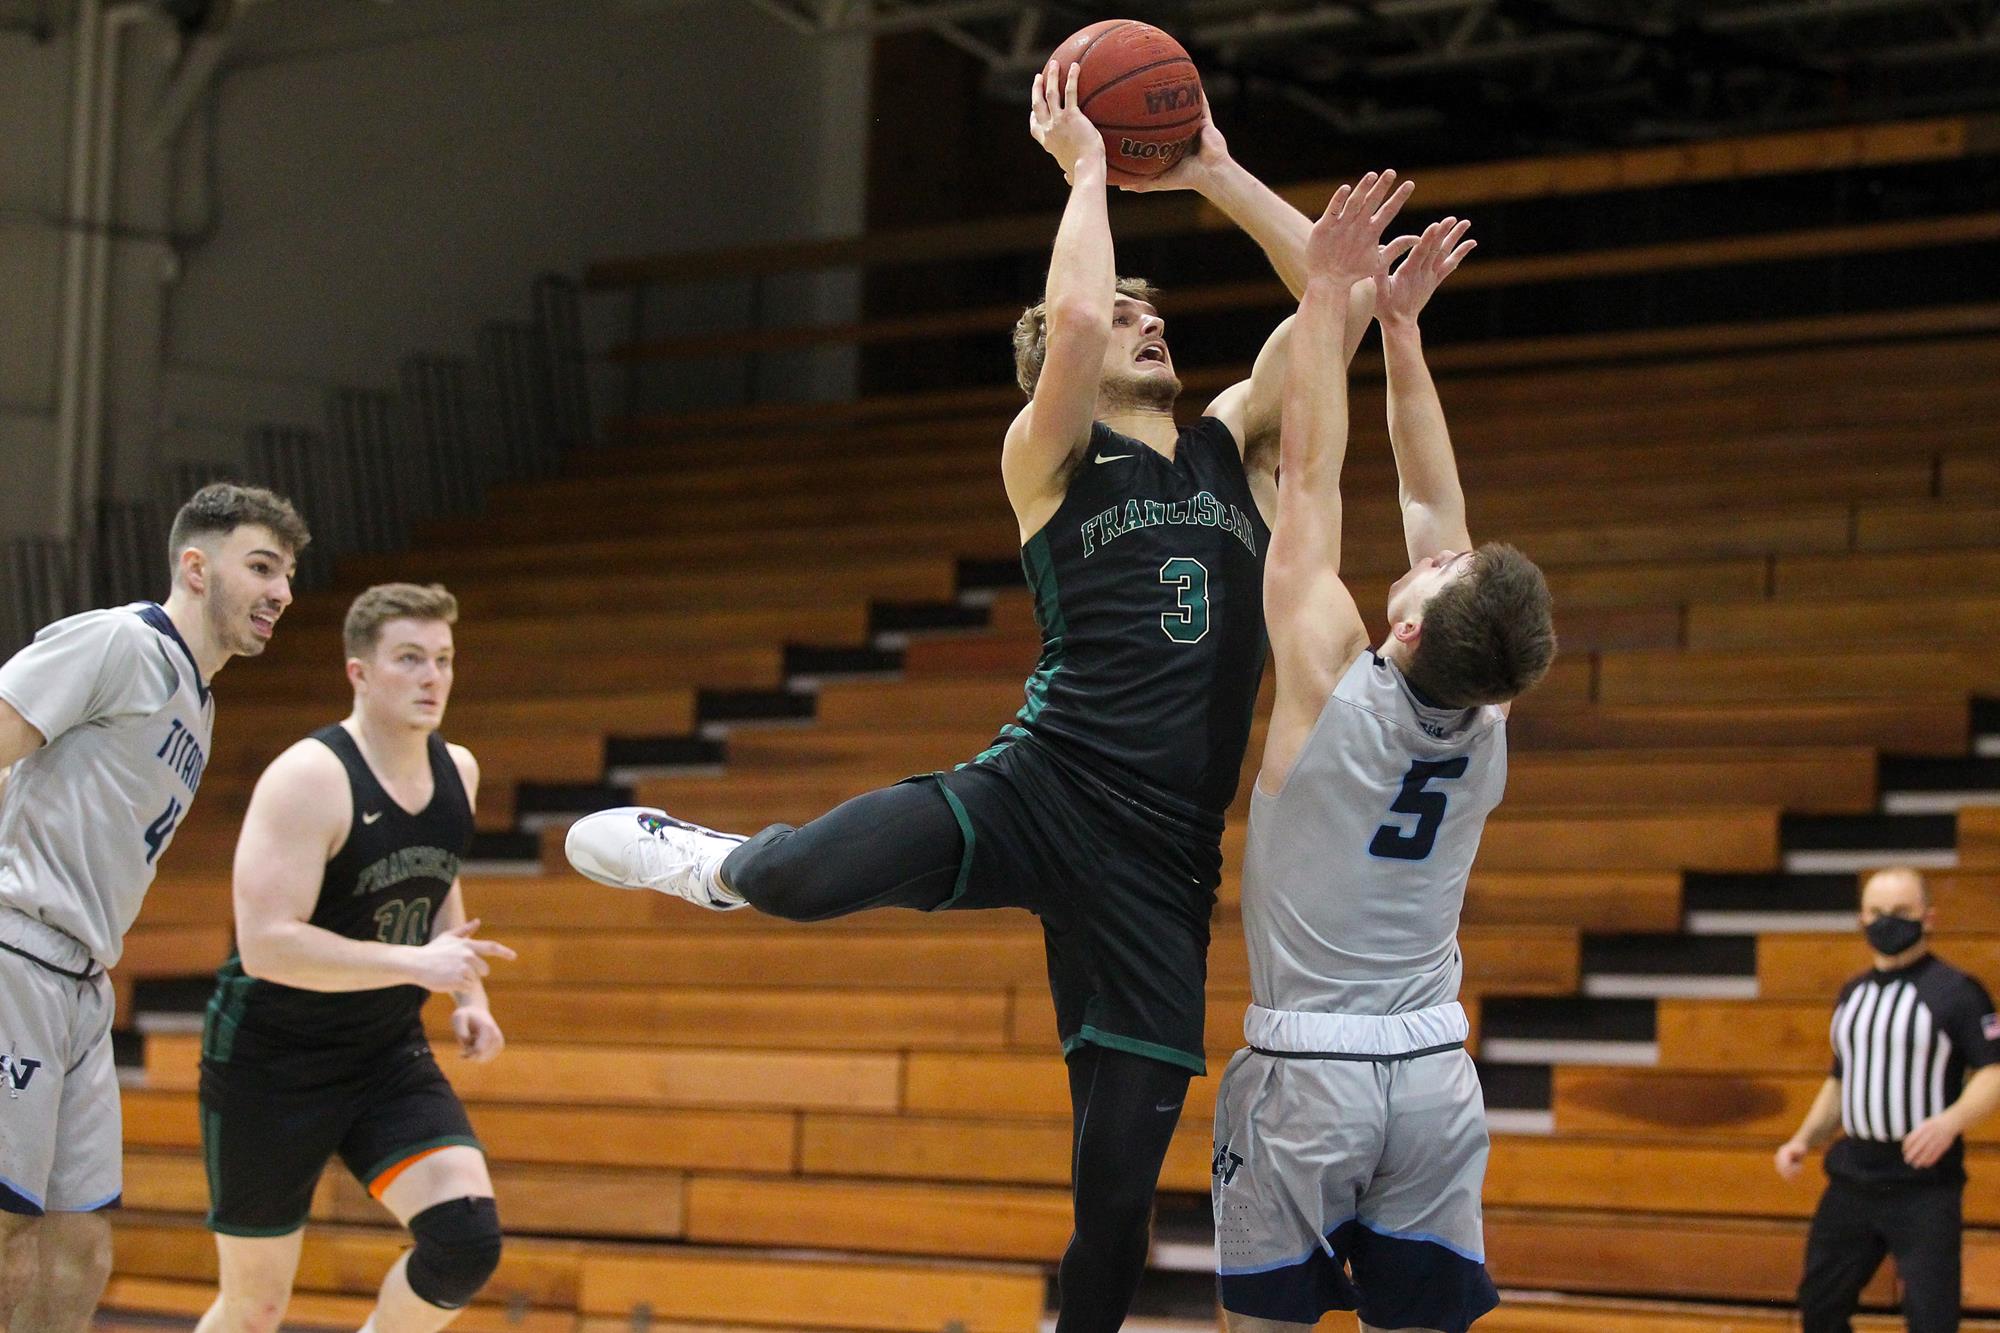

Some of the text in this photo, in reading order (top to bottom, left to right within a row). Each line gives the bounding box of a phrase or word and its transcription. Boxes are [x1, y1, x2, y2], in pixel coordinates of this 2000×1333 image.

[1081, 491, 1257, 559] FRANCISCAN
[1159, 557, 1210, 644] 3
[1369, 756, 1469, 861] 5
